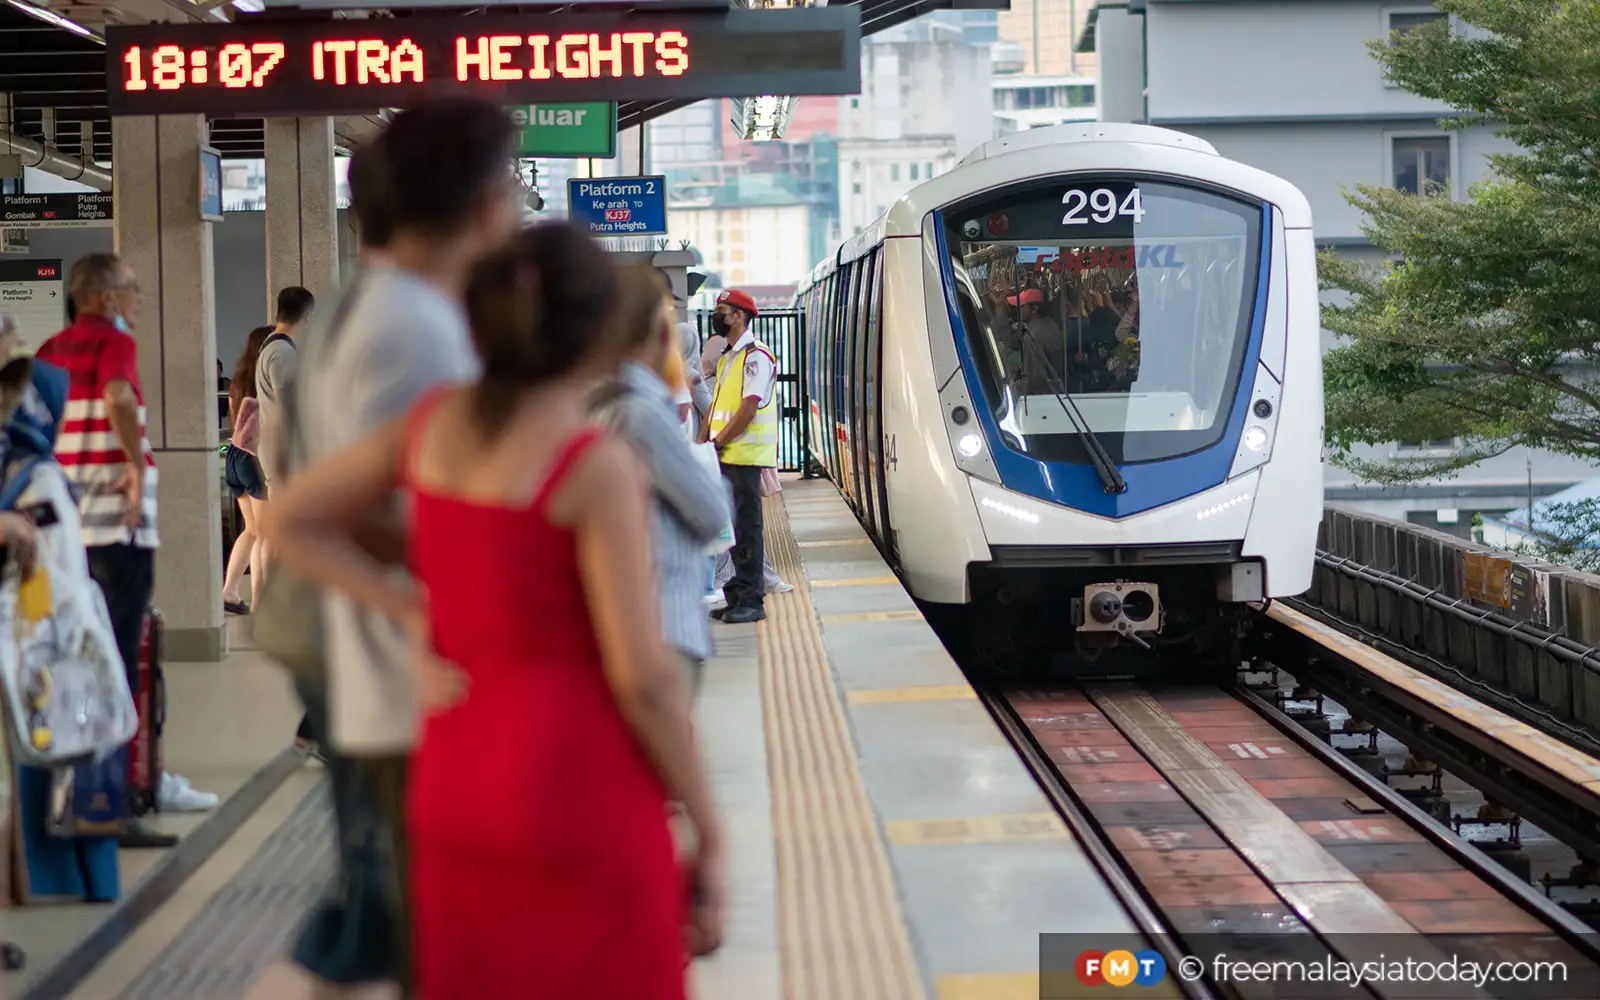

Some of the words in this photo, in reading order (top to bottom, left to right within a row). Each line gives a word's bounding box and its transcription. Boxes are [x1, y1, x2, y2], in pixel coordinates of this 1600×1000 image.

[122, 43, 285, 91] 18:07
[454, 30, 690, 82] HEIGHTS
[511, 104, 587, 126] eluar
[579, 183, 641, 197] Platform
[646, 181, 656, 195] 2
[4, 196, 41, 205] Platform
[43, 196, 48, 204] 1
[78, 194, 113, 203] Platform
[78, 203, 98, 211] Putra
[592, 200, 605, 209] Ke
[607, 199, 628, 209] arah
[1060, 187, 1146, 225] 294
[5, 211, 37, 219] Gombak
[78, 210, 106, 219] Heights
[606, 210, 629, 220] KJ37
[590, 222, 612, 231] Putra
[614, 221, 647, 232] Heights
[2, 288, 28, 296] Platform
